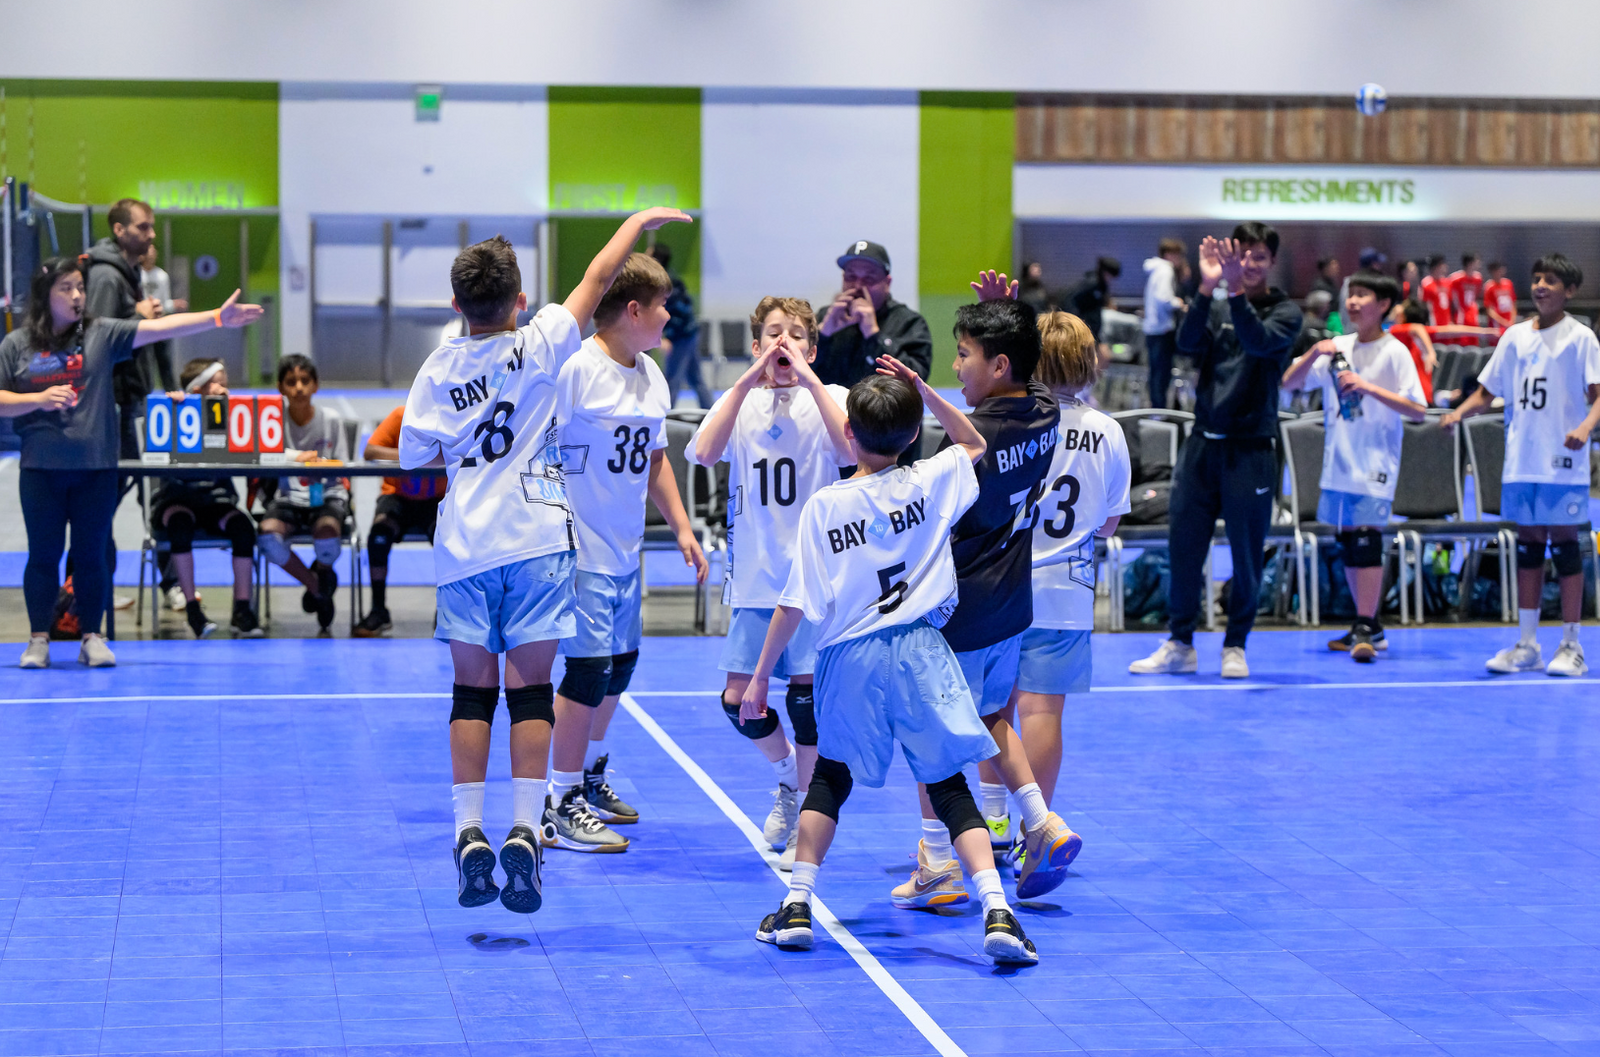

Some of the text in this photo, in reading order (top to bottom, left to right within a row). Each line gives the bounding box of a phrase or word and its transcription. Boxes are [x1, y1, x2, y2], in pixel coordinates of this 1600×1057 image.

[138, 180, 245, 209] WOMEN
[554, 183, 626, 211] FIRST
[1222, 178, 1416, 204] REFRESHMENTS
[854, 241, 868, 255] P
[449, 375, 489, 412] BAY
[149, 403, 201, 449] 09
[212, 402, 222, 424] 1
[229, 403, 283, 449] 06
[607, 424, 650, 474] 38
[996, 441, 1026, 474] BAY
[1065, 428, 1105, 454] BAY
[752, 457, 797, 506] 10
[827, 497, 926, 554] BAY TO BAY
[876, 561, 909, 614] 5
